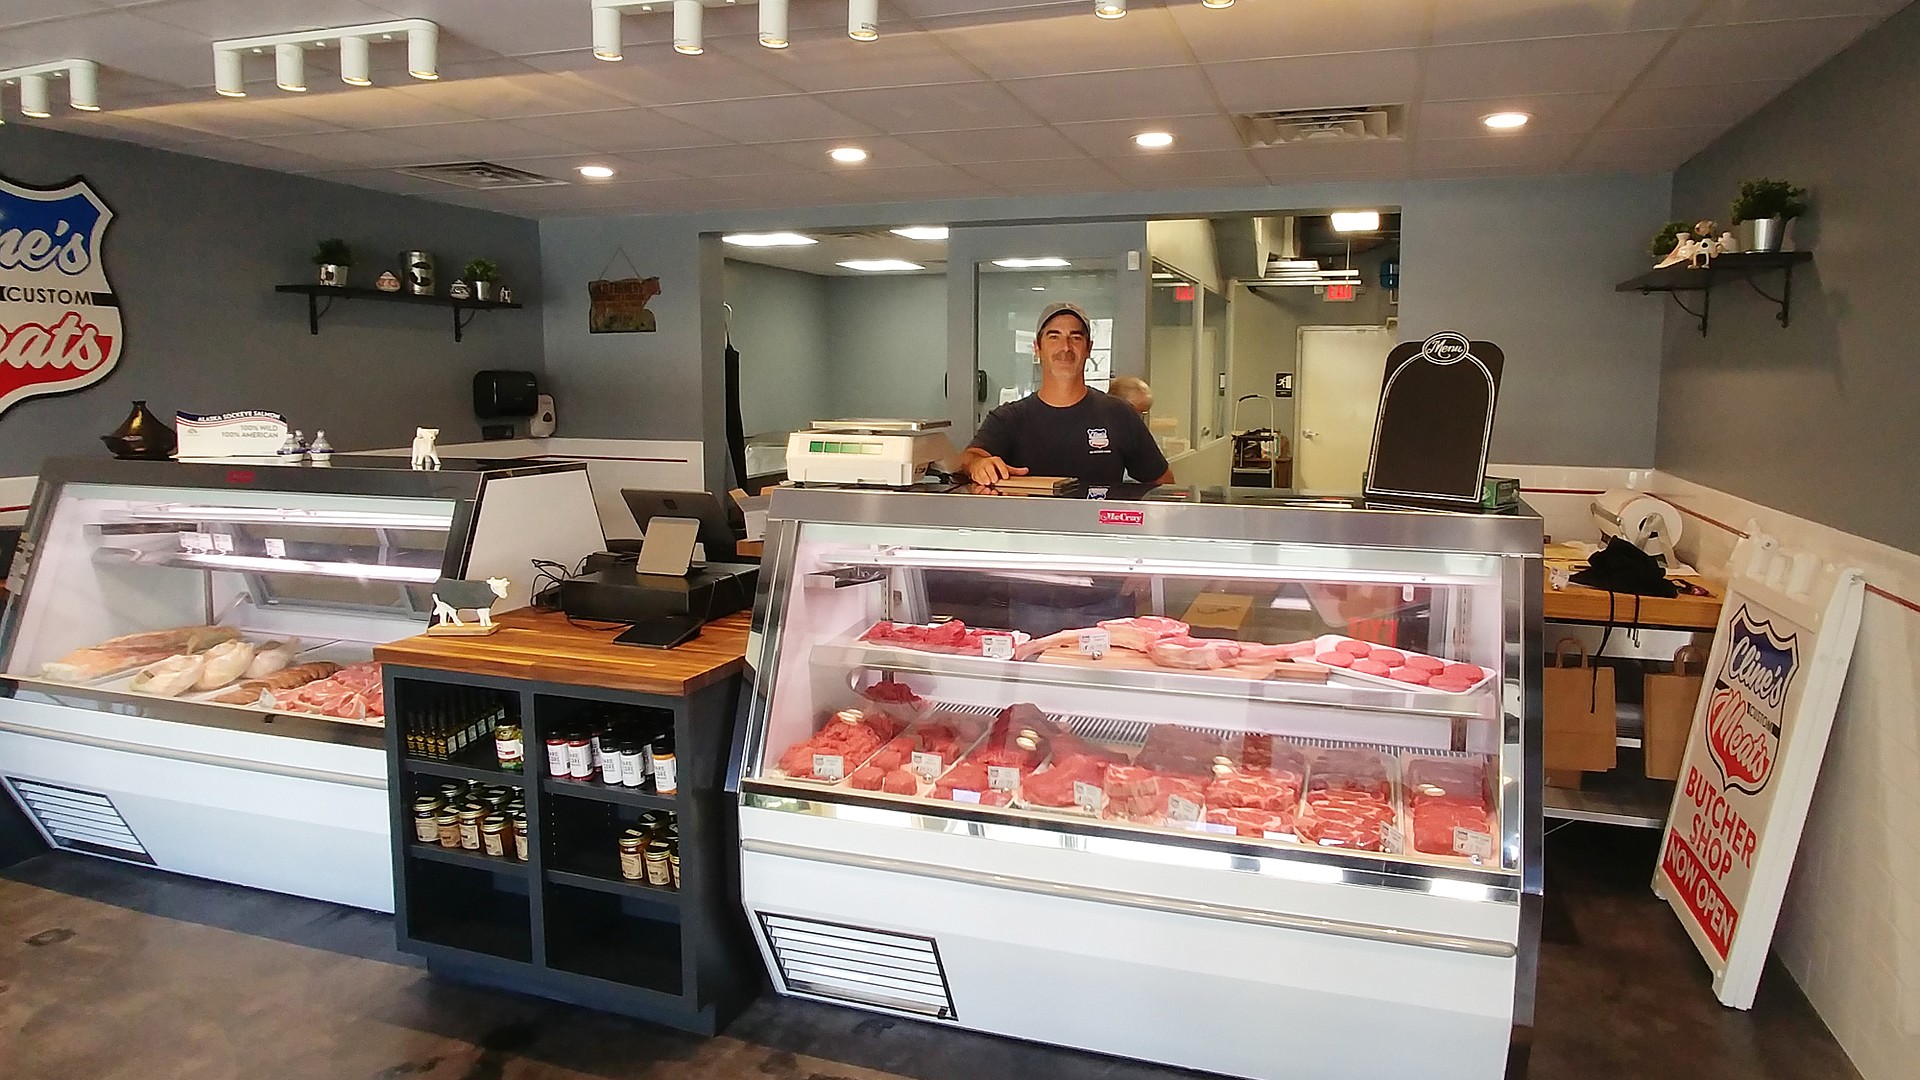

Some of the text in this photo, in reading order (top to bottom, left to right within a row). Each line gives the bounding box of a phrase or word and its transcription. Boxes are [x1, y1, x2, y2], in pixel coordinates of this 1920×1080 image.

[6, 286, 91, 306] CUSTOM
[1426, 339, 1464, 359] Menu
[222, 411, 252, 420] SOCKEYE
[253, 410, 281, 420] SALMON
[1107, 512, 1141, 523] McCray
[1729, 635, 1784, 708] Cline's
[1711, 688, 1769, 781] Meats
[1750, 705, 1772, 731] CUSTOM
[1685, 765, 1757, 869] BUTCHER
[1689, 812, 1733, 881] SHOP
[1667, 840, 1734, 947] NOW OPEN
